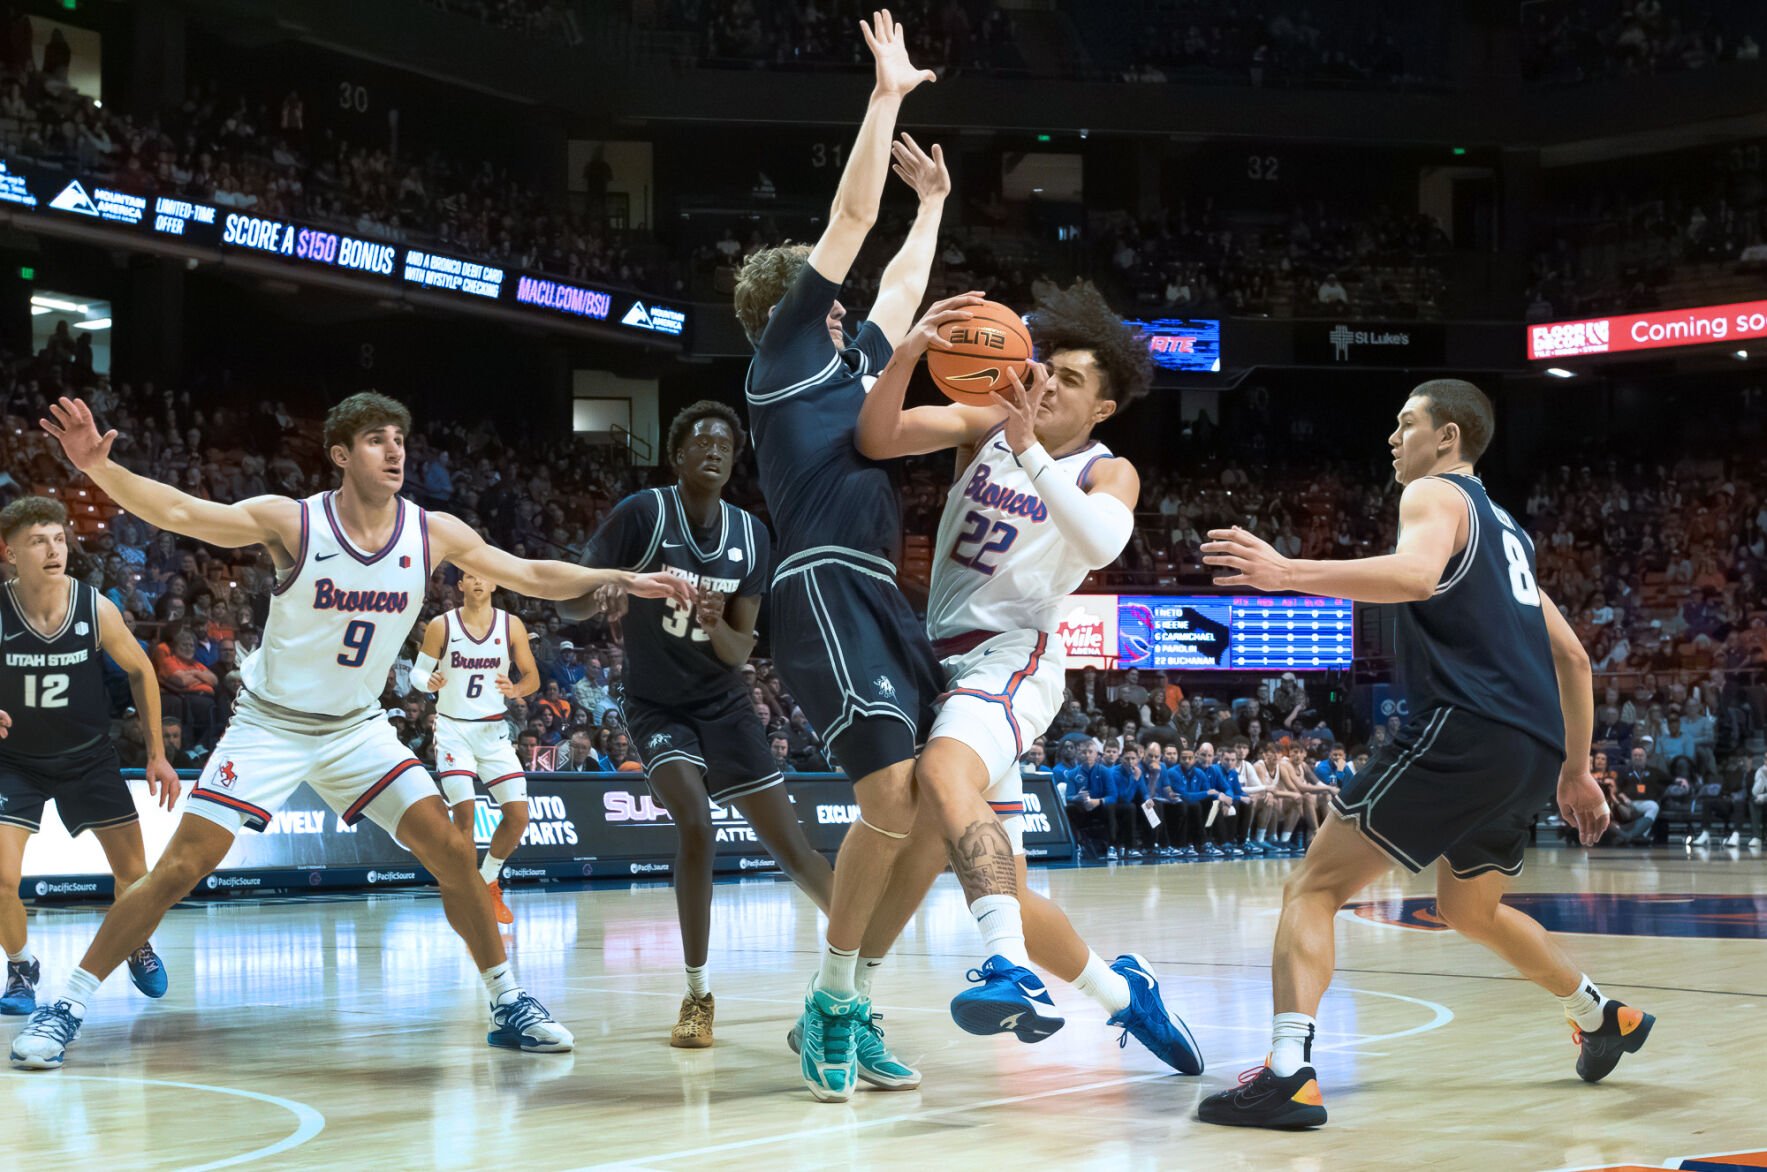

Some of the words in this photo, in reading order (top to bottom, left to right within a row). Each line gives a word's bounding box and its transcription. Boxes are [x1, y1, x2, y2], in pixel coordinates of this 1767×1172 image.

[338, 80, 369, 113] 30
[811, 142, 842, 169] 31
[1247, 155, 1279, 181] 32
[94, 188, 147, 209] MOUNTAIN
[97, 202, 143, 219] AMERICA
[155, 197, 217, 224] LIMITED-TIME
[155, 215, 185, 235] OFFER
[223, 213, 282, 252] SCORE
[281, 225, 295, 255] A
[296, 228, 337, 263] $150
[338, 237, 396, 275] BONUS
[406, 250, 424, 267] AND
[423, 253, 431, 269] A
[462, 262, 484, 279] DEBIT
[482, 267, 503, 284] CARD
[404, 265, 426, 282] WITH
[462, 278, 500, 299] CHECKING
[516, 275, 612, 320] MACU.COM/BSU
[948, 327, 1006, 350] ELITE
[1355, 331, 1369, 345] St
[1370, 331, 1409, 345] Luke's
[1631, 315, 1728, 343] Coming
[1736, 312, 1767, 332] so
[963, 463, 1048, 523] Broncos
[949, 510, 1019, 577] 22
[1502, 528, 1540, 607] 8
[313, 577, 409, 614] Broncos
[336, 620, 376, 668] 9
[1162, 632, 1216, 641] CARMICHAEL
[5, 653, 46, 667] UTAH
[47, 648, 89, 667] STATE
[450, 650, 501, 670] Broncos
[1154, 656, 1167, 665] 22
[1167, 656, 1215, 665] BUCHANAN
[24, 673, 70, 708] 12
[466, 674, 485, 699] 6
[520, 820, 578, 846] PARTS
[48, 882, 97, 894] PacificSource
[217, 875, 261, 888] PacificSource
[377, 870, 416, 882] PacificSource
